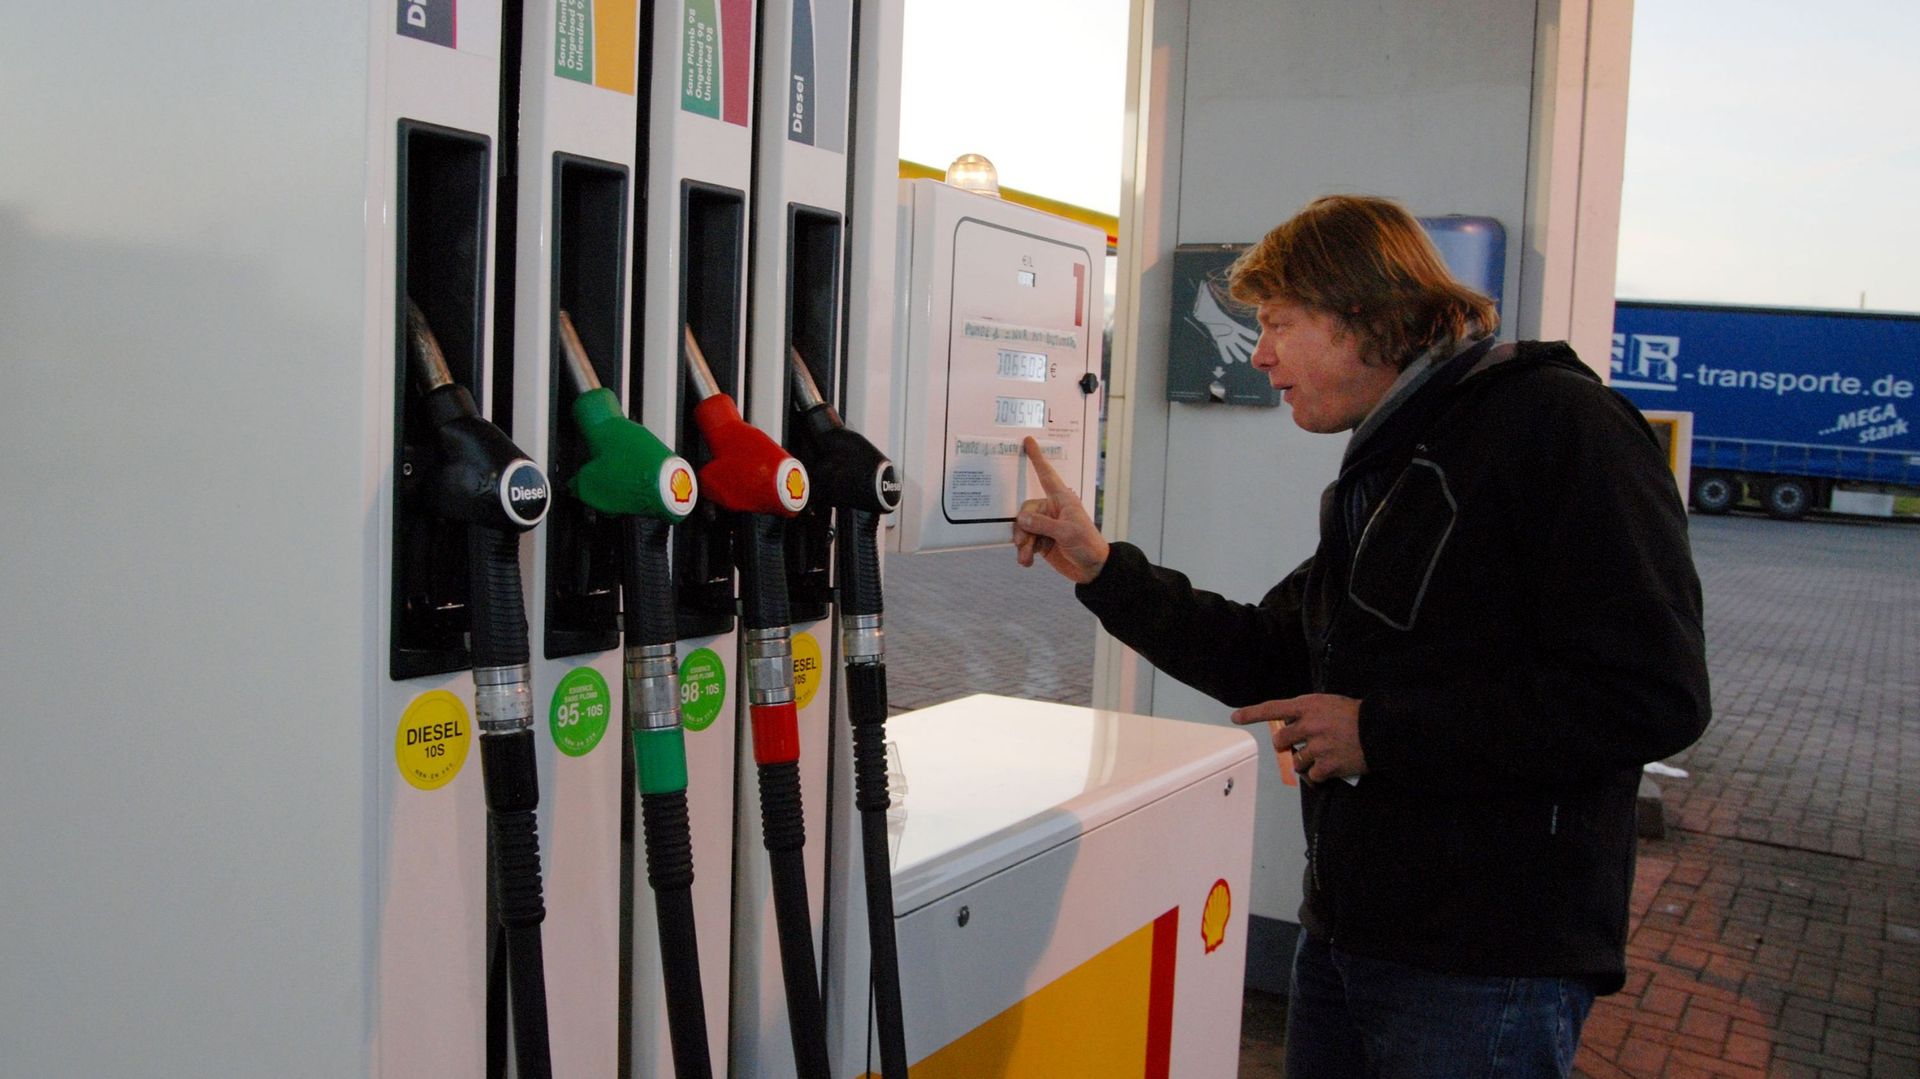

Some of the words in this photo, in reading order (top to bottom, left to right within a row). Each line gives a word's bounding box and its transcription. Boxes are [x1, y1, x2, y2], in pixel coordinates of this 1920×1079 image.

[688, 8, 696, 24] 98
[576, 12, 585, 71] Unleaded
[697, 22, 705, 38] 98
[705, 26, 714, 42] 98
[559, 37, 567, 67] Sans
[687, 28, 696, 65] Plomb
[686, 69, 694, 97] Sans
[704, 45, 713, 102] Unleaded
[793, 74, 804, 134] Diesel
[1072, 262, 1085, 327] 1
[1050, 362, 1058, 378] €
[1048, 407, 1054, 423] L
[1858, 417, 1910, 444] stark
[511, 484, 547, 501] Diesel
[793, 657, 817, 672] ESEL
[406, 720, 463, 746] DIESEL
[424, 743, 445, 758] 10S
